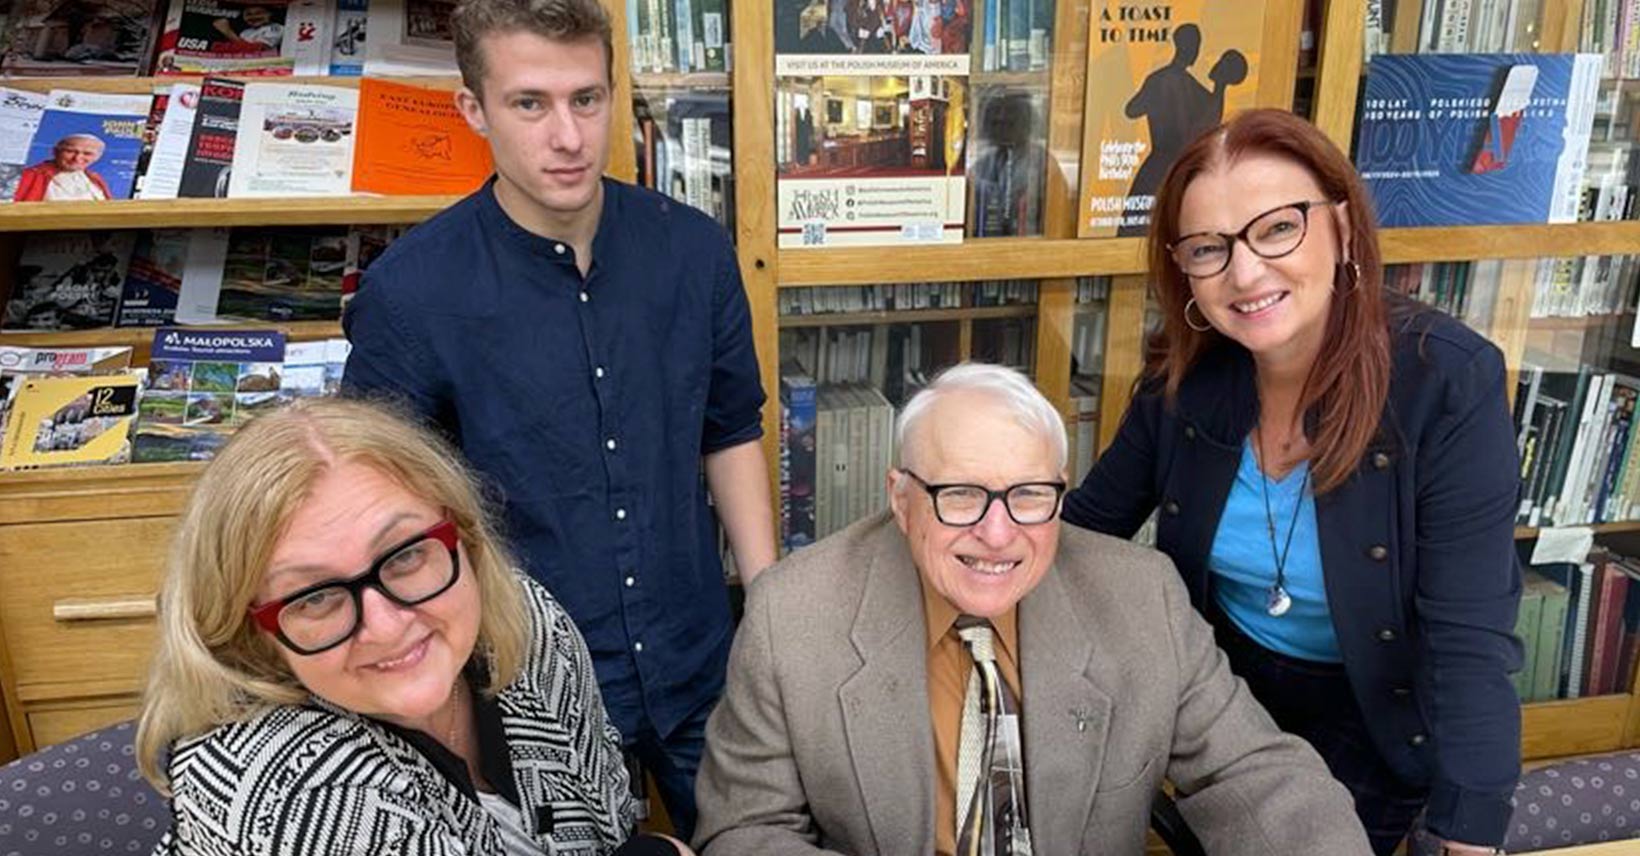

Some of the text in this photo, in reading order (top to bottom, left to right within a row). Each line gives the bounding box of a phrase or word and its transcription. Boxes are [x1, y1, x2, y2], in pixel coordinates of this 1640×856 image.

[1102, 6, 1171, 21] A TOAST
[1101, 27, 1168, 43] TO TIME
[177, 37, 208, 50] USA
[786, 61, 806, 70] VISIT
[808, 61, 818, 70] US
[832, 61, 846, 70] THE
[848, 61, 875, 70] POLISH
[877, 60, 909, 70] MUSEUM
[912, 60, 922, 70] OF
[924, 60, 958, 70] AMERICA
[380, 94, 458, 110] EAST EUROPE
[1366, 99, 1385, 109] 100
[1387, 99, 1408, 109] LAT
[1430, 98, 1491, 108] POLSKIEGO
[1364, 110, 1384, 120] 100
[1386, 110, 1421, 120] YEARS
[1428, 110, 1443, 119] OF
[1450, 109, 1490, 119] POLISH
[1091, 195, 1157, 210] POLISH MUSEU
[183, 336, 274, 348] MAŁOPOLSKA
[35, 352, 87, 365] program
[97, 387, 114, 405] 12
[93, 402, 126, 414] Cities
